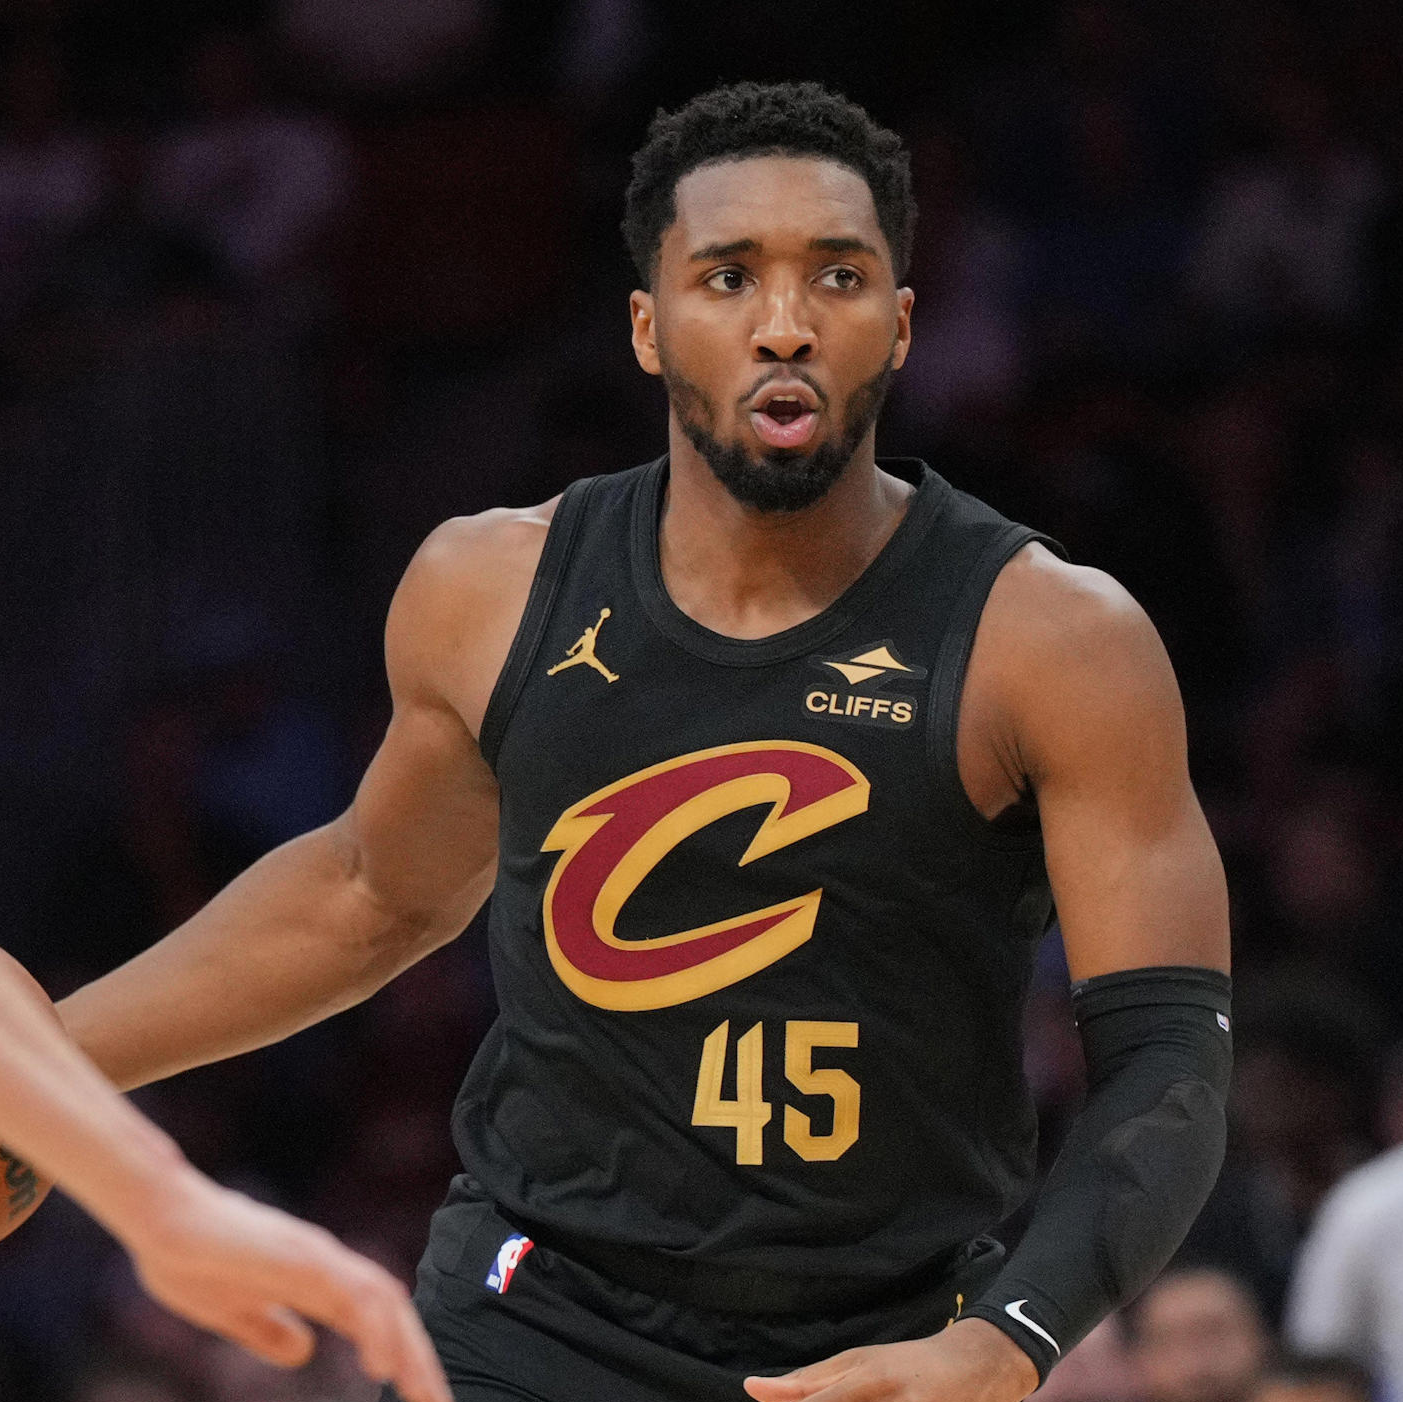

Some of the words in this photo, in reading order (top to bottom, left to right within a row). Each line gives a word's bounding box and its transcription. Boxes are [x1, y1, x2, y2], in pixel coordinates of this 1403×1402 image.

[805, 690, 913, 724] CLIFFS
[540, 739, 871, 1012] C
[690, 1018, 861, 1166] 45
